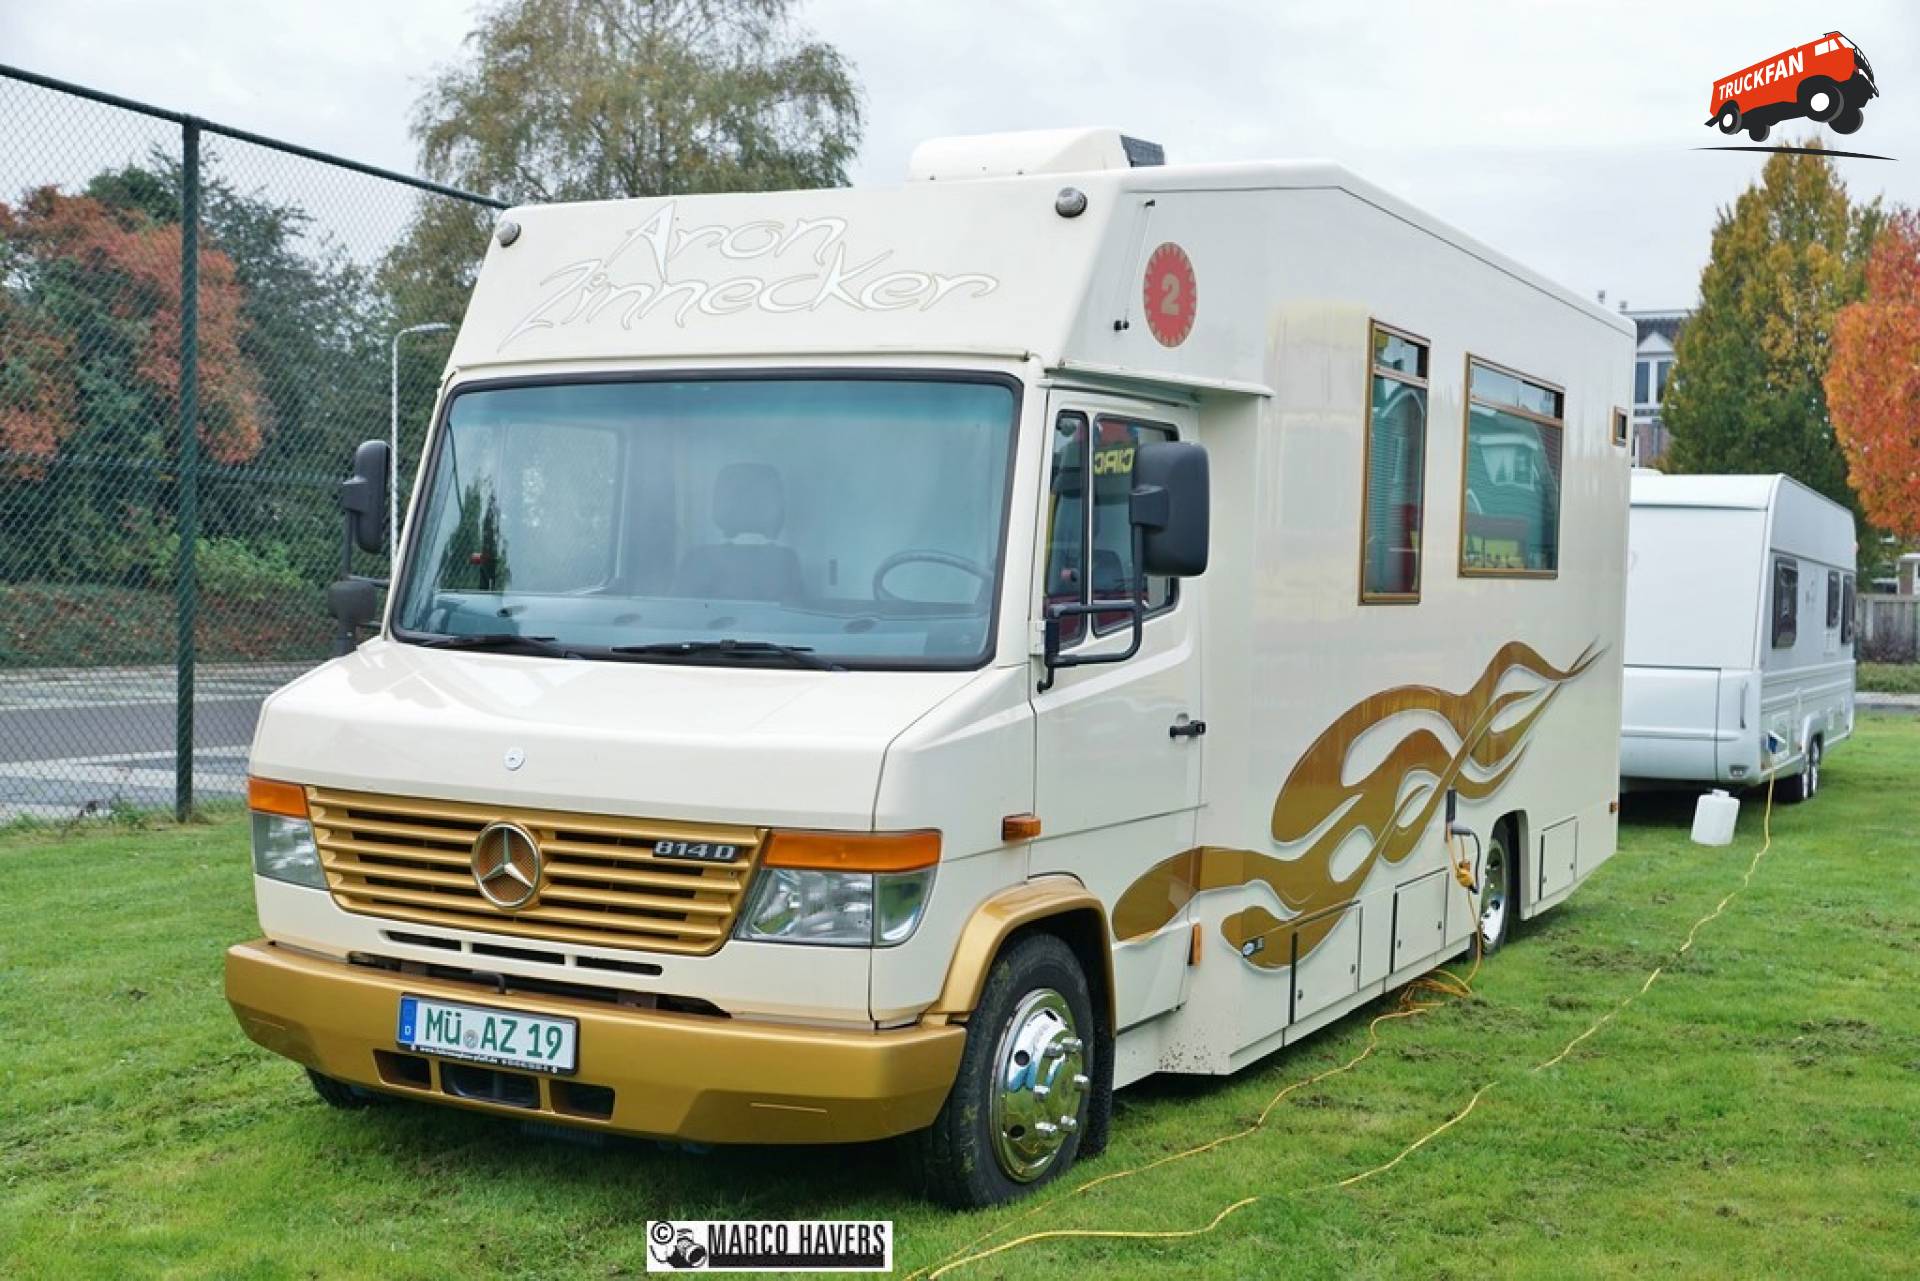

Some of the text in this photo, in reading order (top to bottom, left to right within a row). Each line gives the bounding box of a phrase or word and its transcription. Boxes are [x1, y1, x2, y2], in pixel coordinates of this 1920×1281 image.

[604, 200, 847, 284] Aron
[497, 243, 1000, 353] Zinnecker
[1161, 271, 1180, 316] 2
[655, 841, 736, 860] 814 D
[425, 1007, 462, 1045] Mü
[480, 1016, 519, 1054] AZ
[526, 1023, 563, 1060] 19
